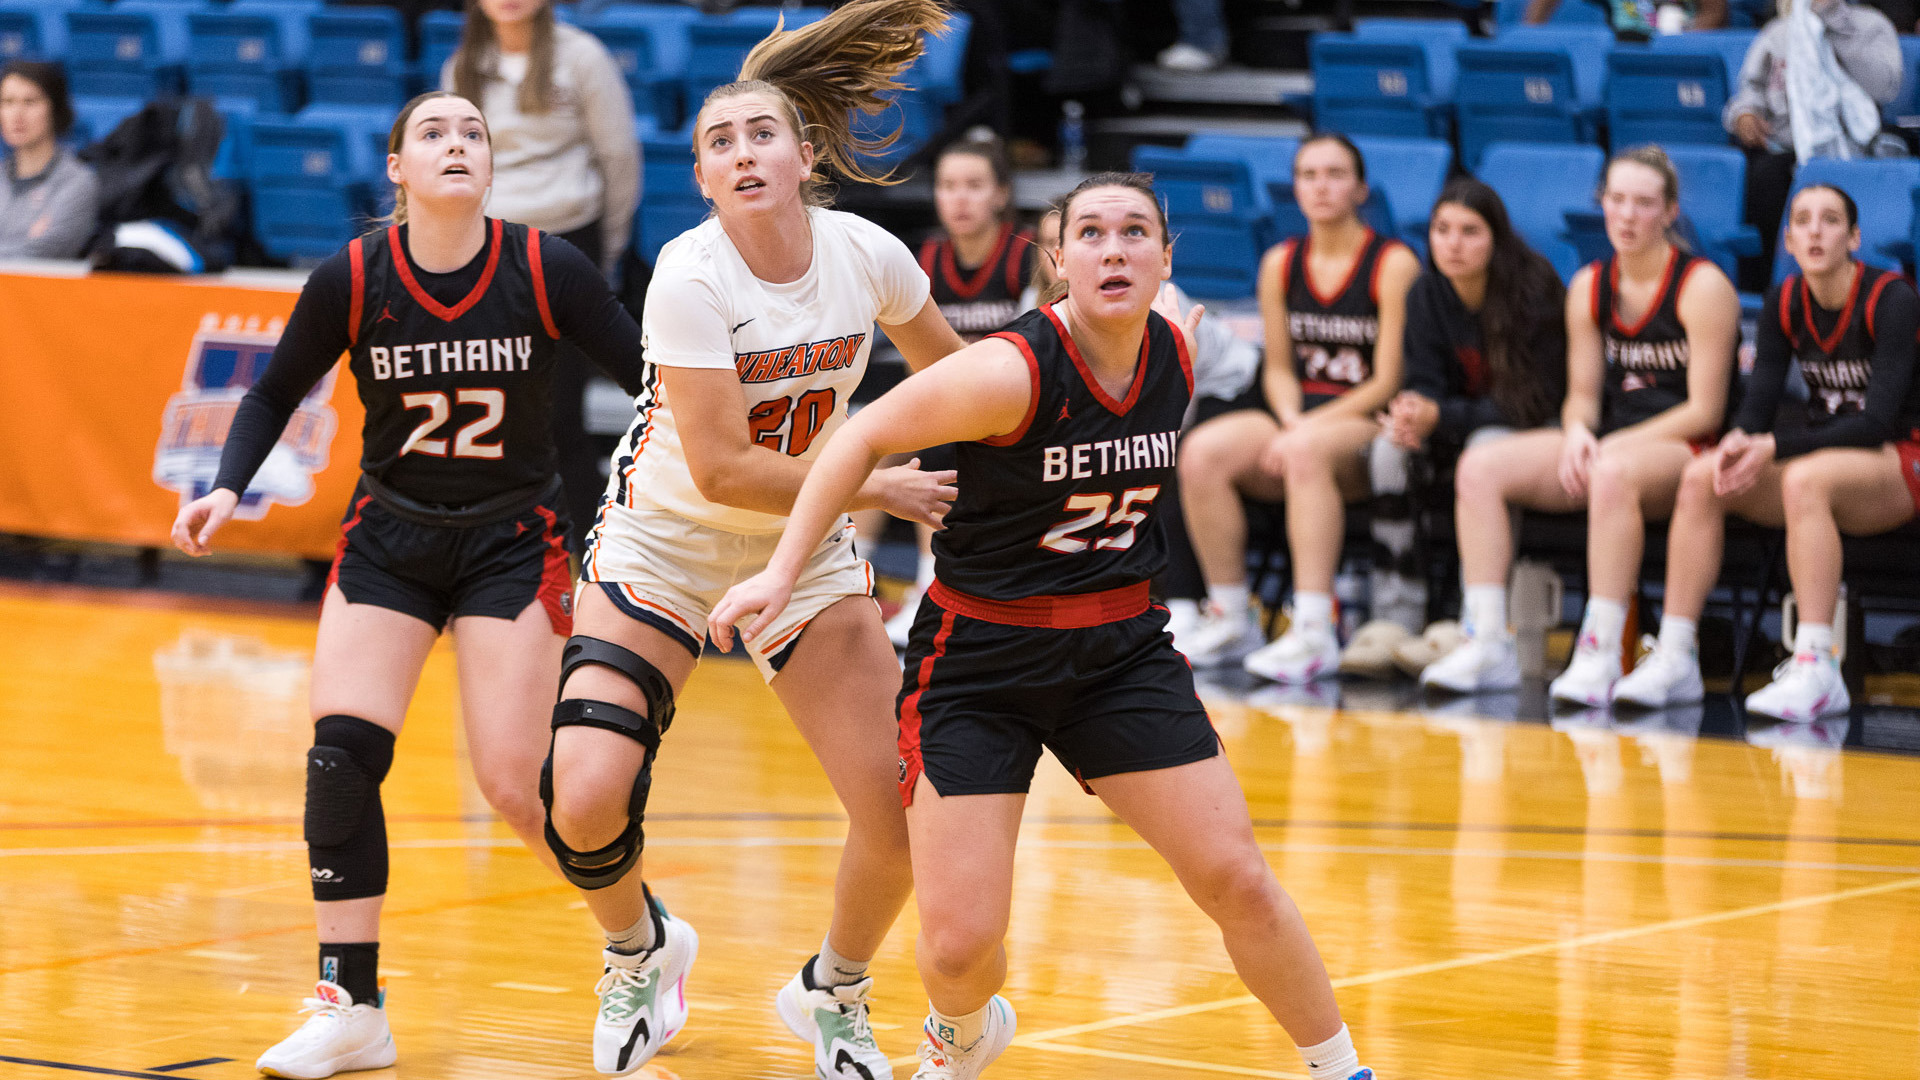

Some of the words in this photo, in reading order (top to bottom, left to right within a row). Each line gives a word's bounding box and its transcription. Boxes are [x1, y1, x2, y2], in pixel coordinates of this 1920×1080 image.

[370, 335, 533, 380] BETHANY
[399, 387, 506, 460] 22
[748, 387, 837, 457] 20
[1036, 484, 1161, 555] 25
